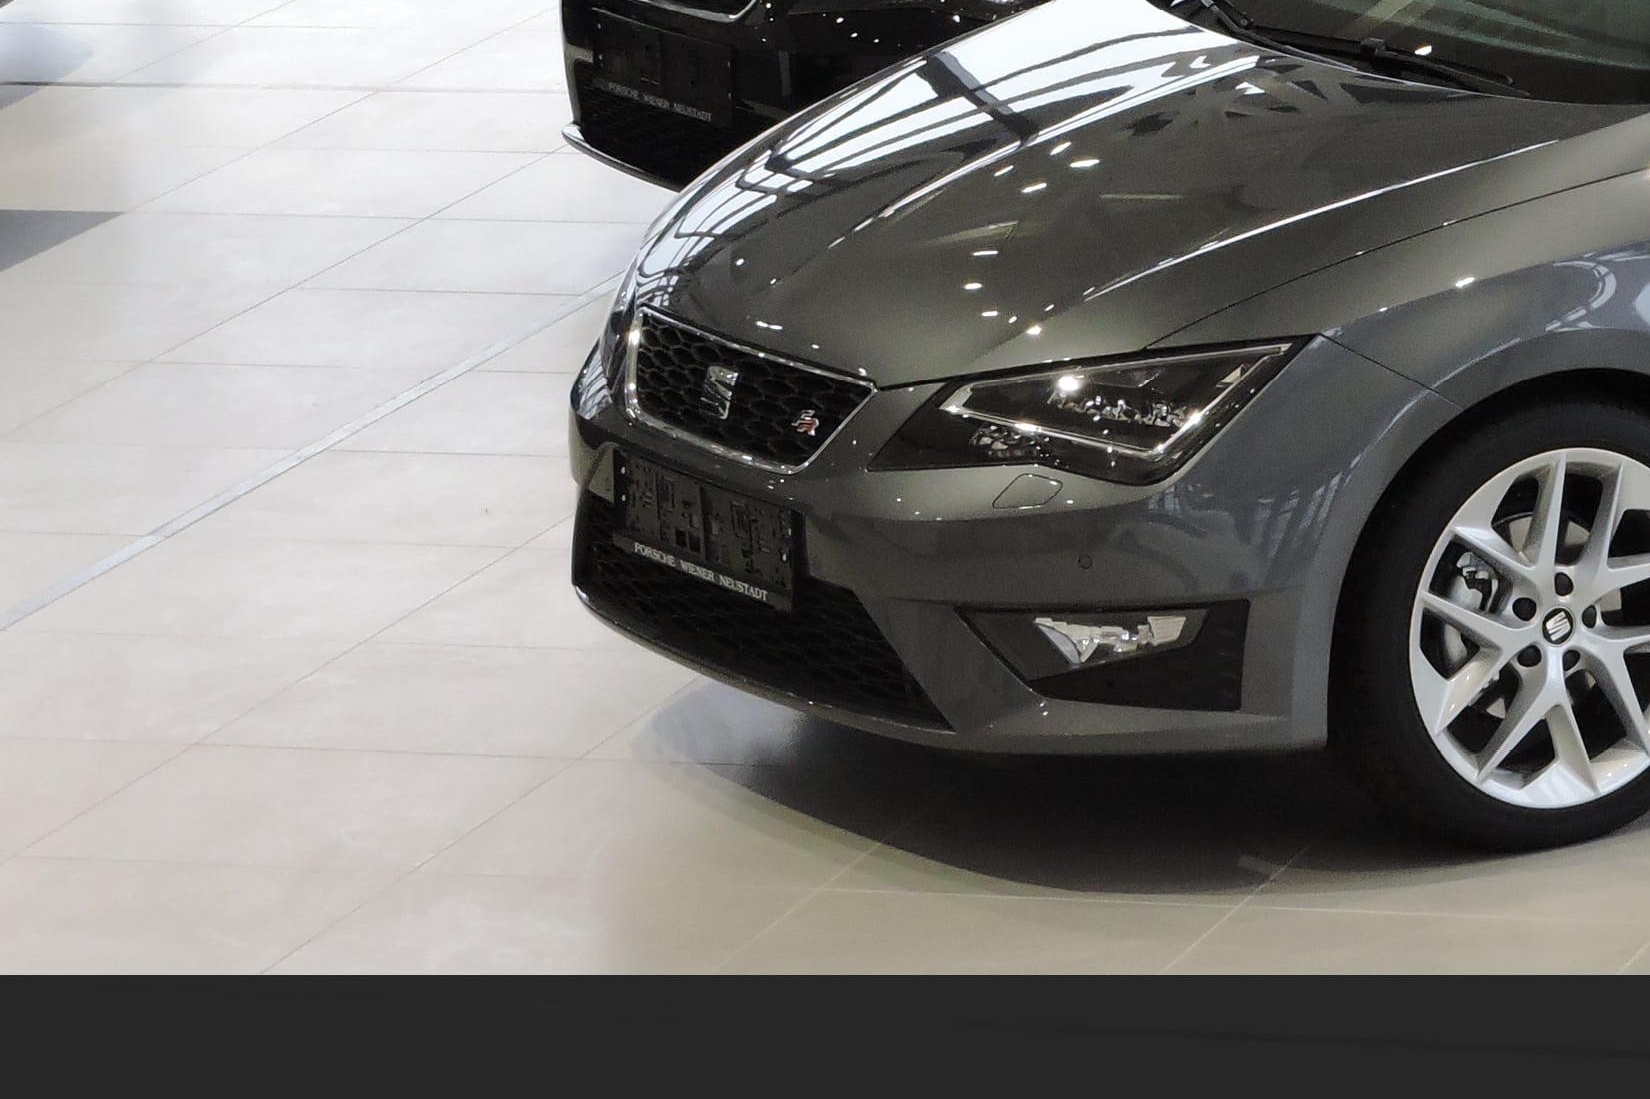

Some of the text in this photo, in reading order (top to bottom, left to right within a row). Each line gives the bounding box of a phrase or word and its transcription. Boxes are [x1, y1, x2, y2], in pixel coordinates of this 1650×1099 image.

[634, 541, 768, 600] PORSCHE WIENER NEUSTADT
